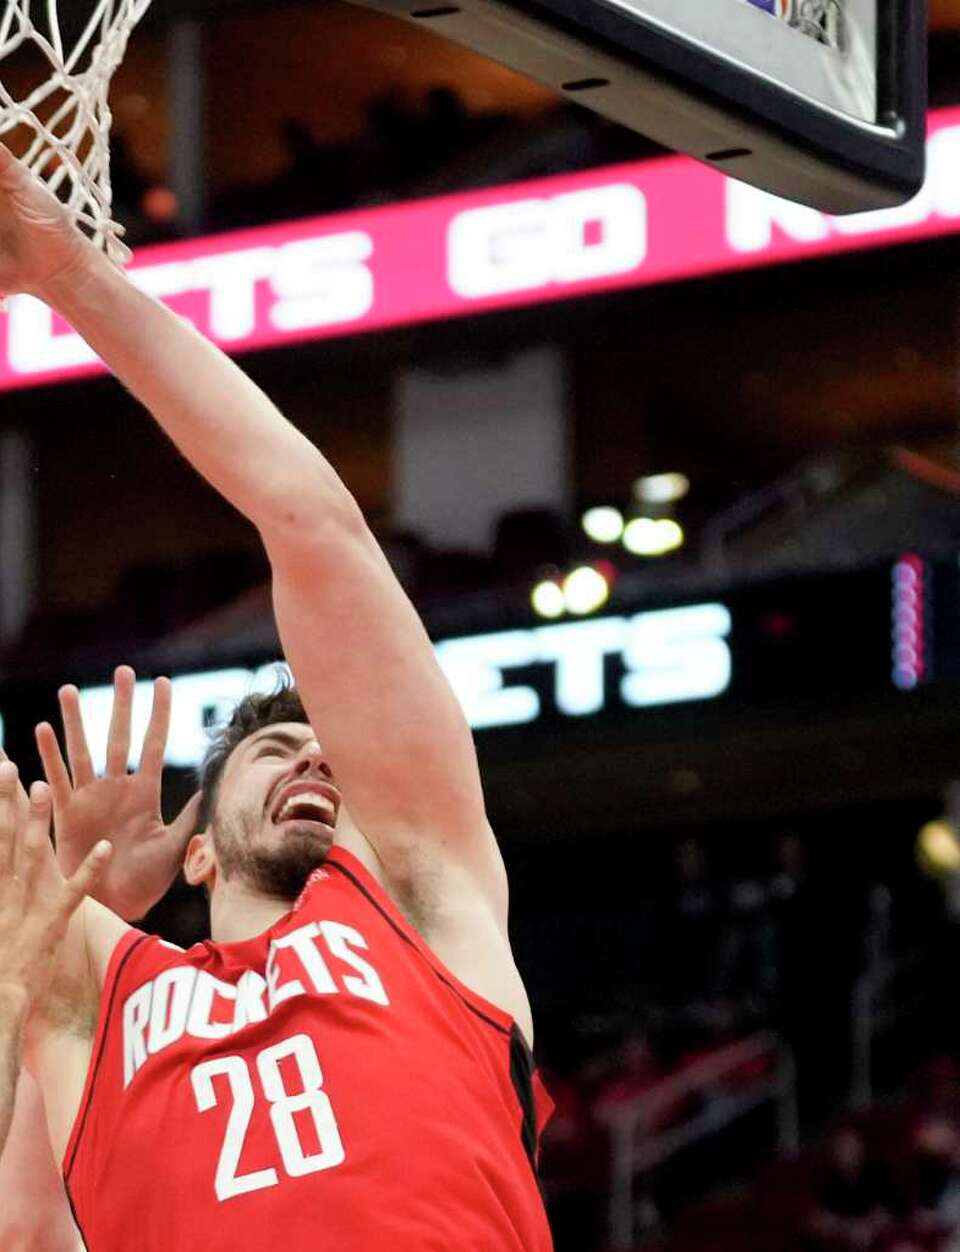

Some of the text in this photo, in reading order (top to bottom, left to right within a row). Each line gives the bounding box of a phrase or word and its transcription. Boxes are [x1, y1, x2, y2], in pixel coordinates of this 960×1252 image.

[446, 183, 647, 299] GO
[122, 920, 390, 1091] ROCKETS
[190, 1033, 345, 1202] 28
